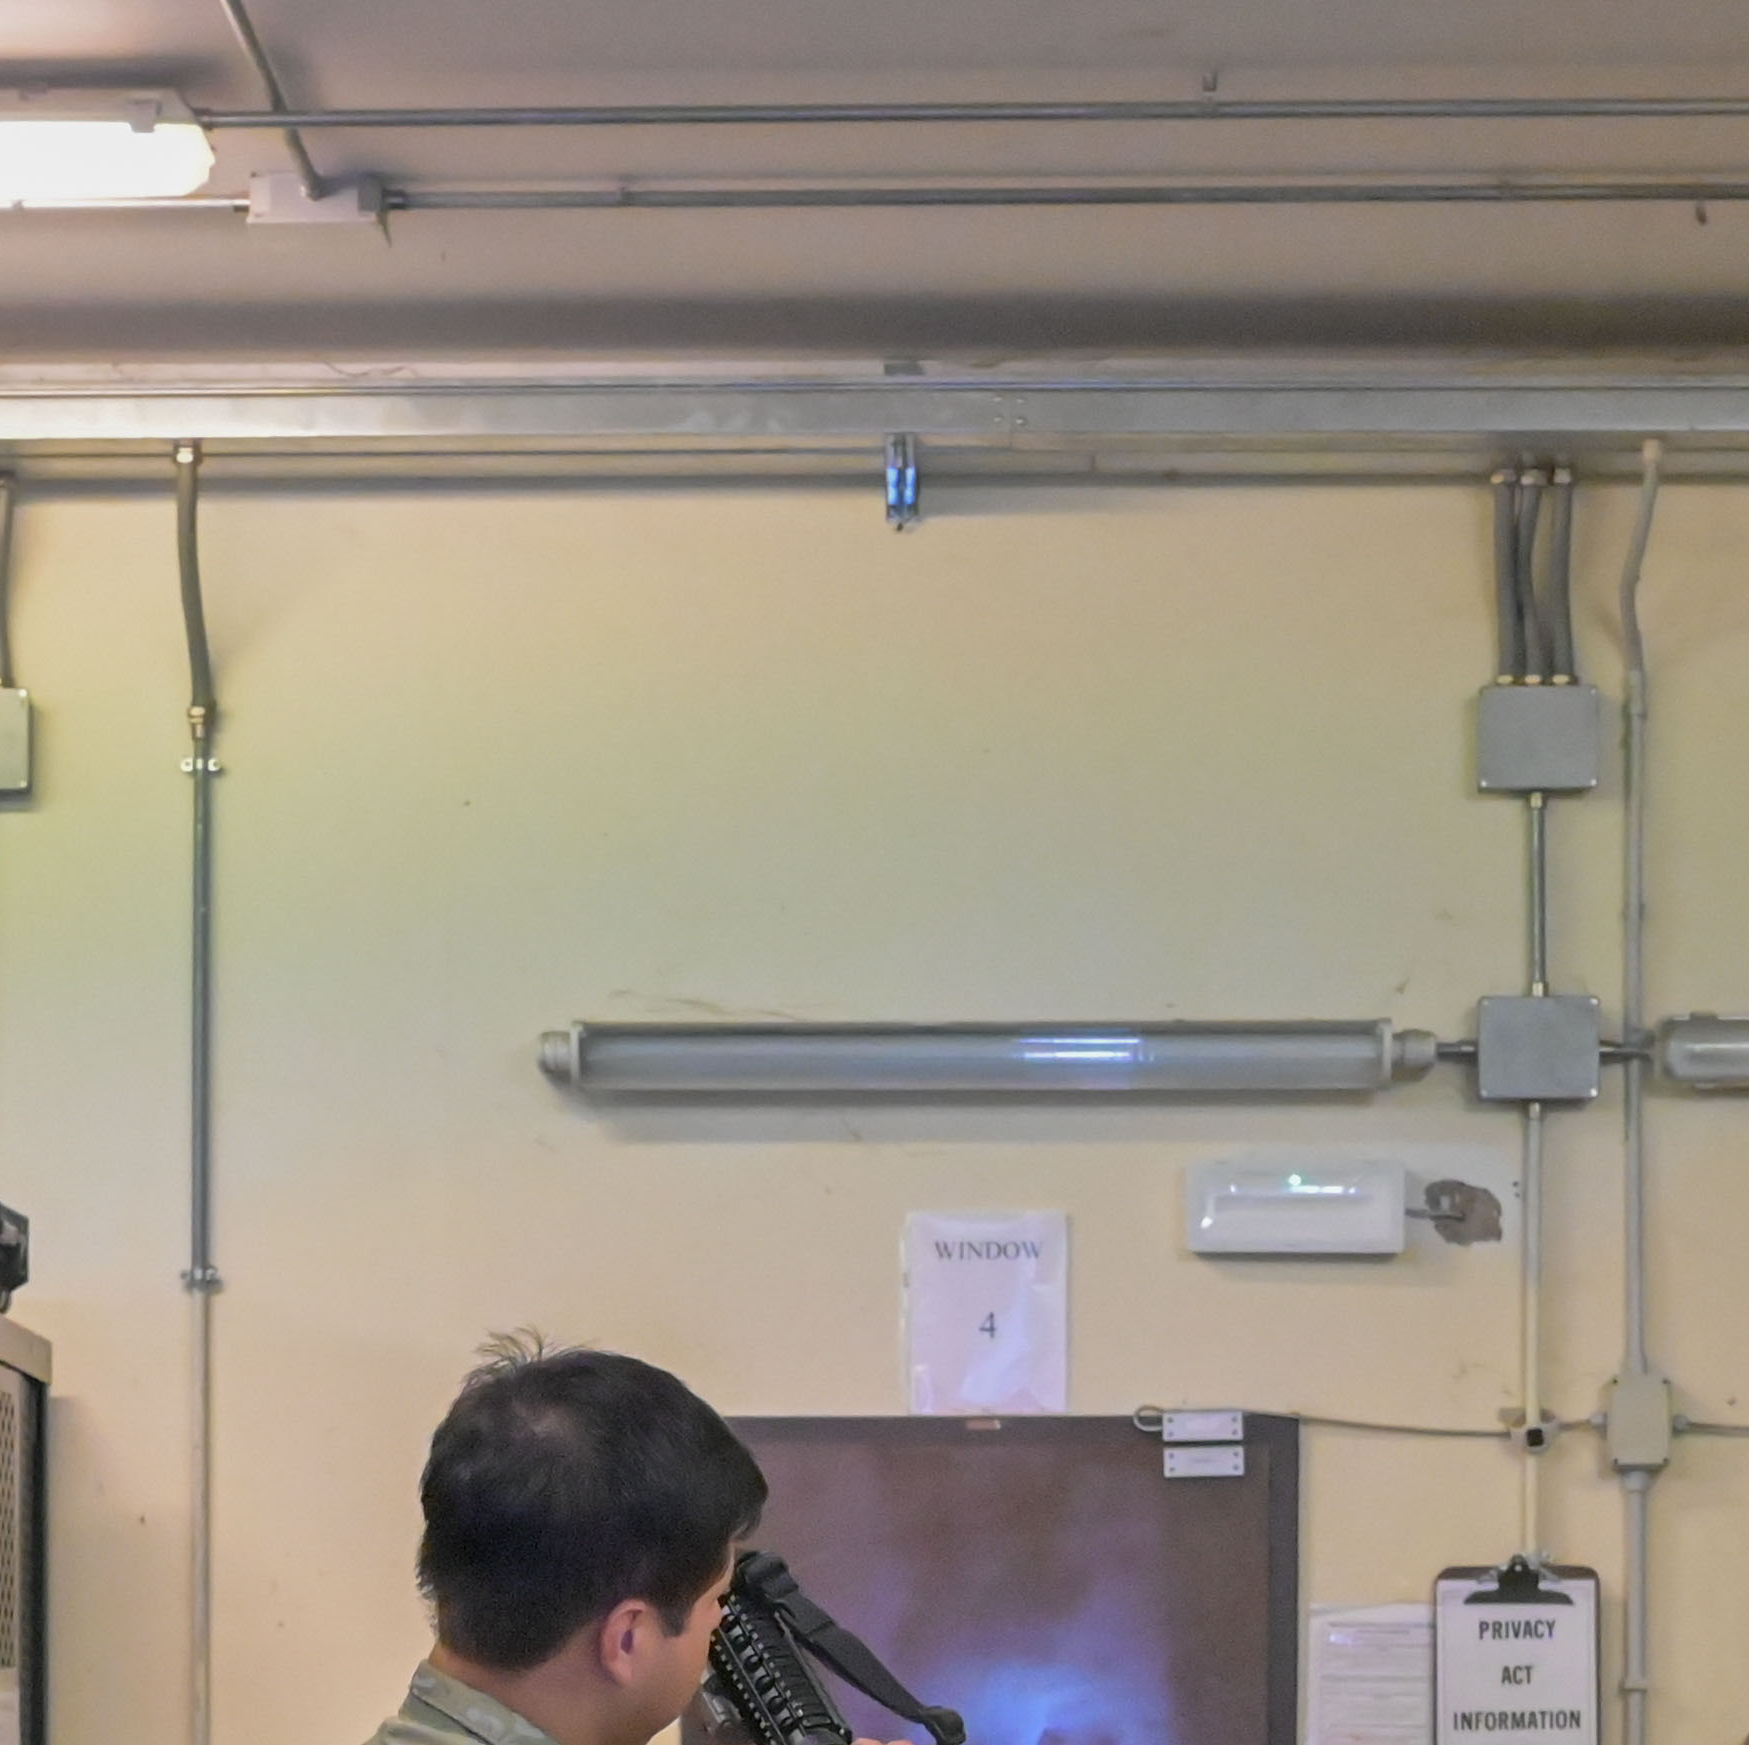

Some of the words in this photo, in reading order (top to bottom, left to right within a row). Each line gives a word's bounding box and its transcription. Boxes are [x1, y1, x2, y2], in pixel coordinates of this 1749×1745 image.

[934, 1240, 1042, 1261] WINDOW
[979, 1311, 996, 1339] 4
[1479, 1620, 1556, 1640] PRIVACY
[1501, 1665, 1533, 1685] ACT
[1453, 1710, 1582, 1731] INFORMATION
